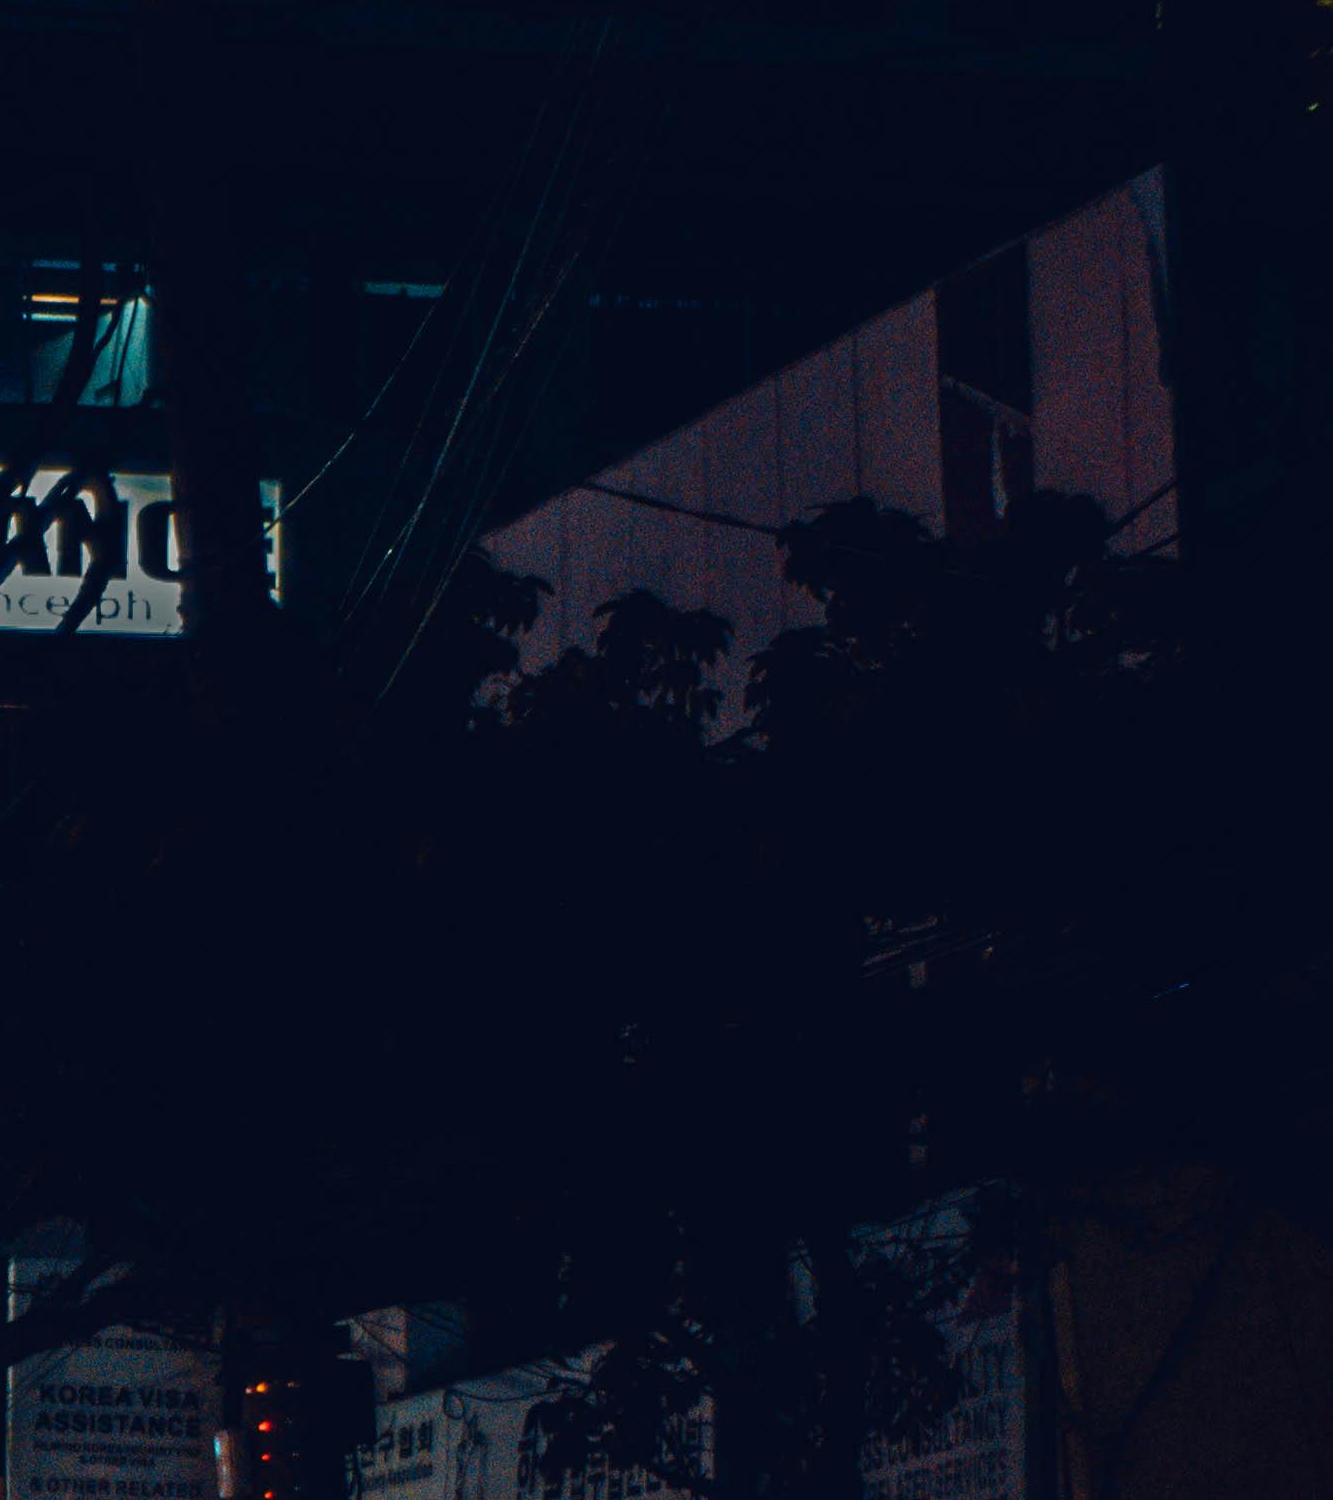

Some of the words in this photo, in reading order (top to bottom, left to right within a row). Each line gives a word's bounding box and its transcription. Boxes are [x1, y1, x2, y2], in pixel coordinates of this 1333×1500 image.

[38, 1383, 136, 1408] KOREA
[140, 1385, 199, 1409] VISA
[35, 1411, 202, 1439] ASSISTANCE
[46, 1477, 110, 1494] OTHER
[115, 1480, 203, 1499] RELATED
